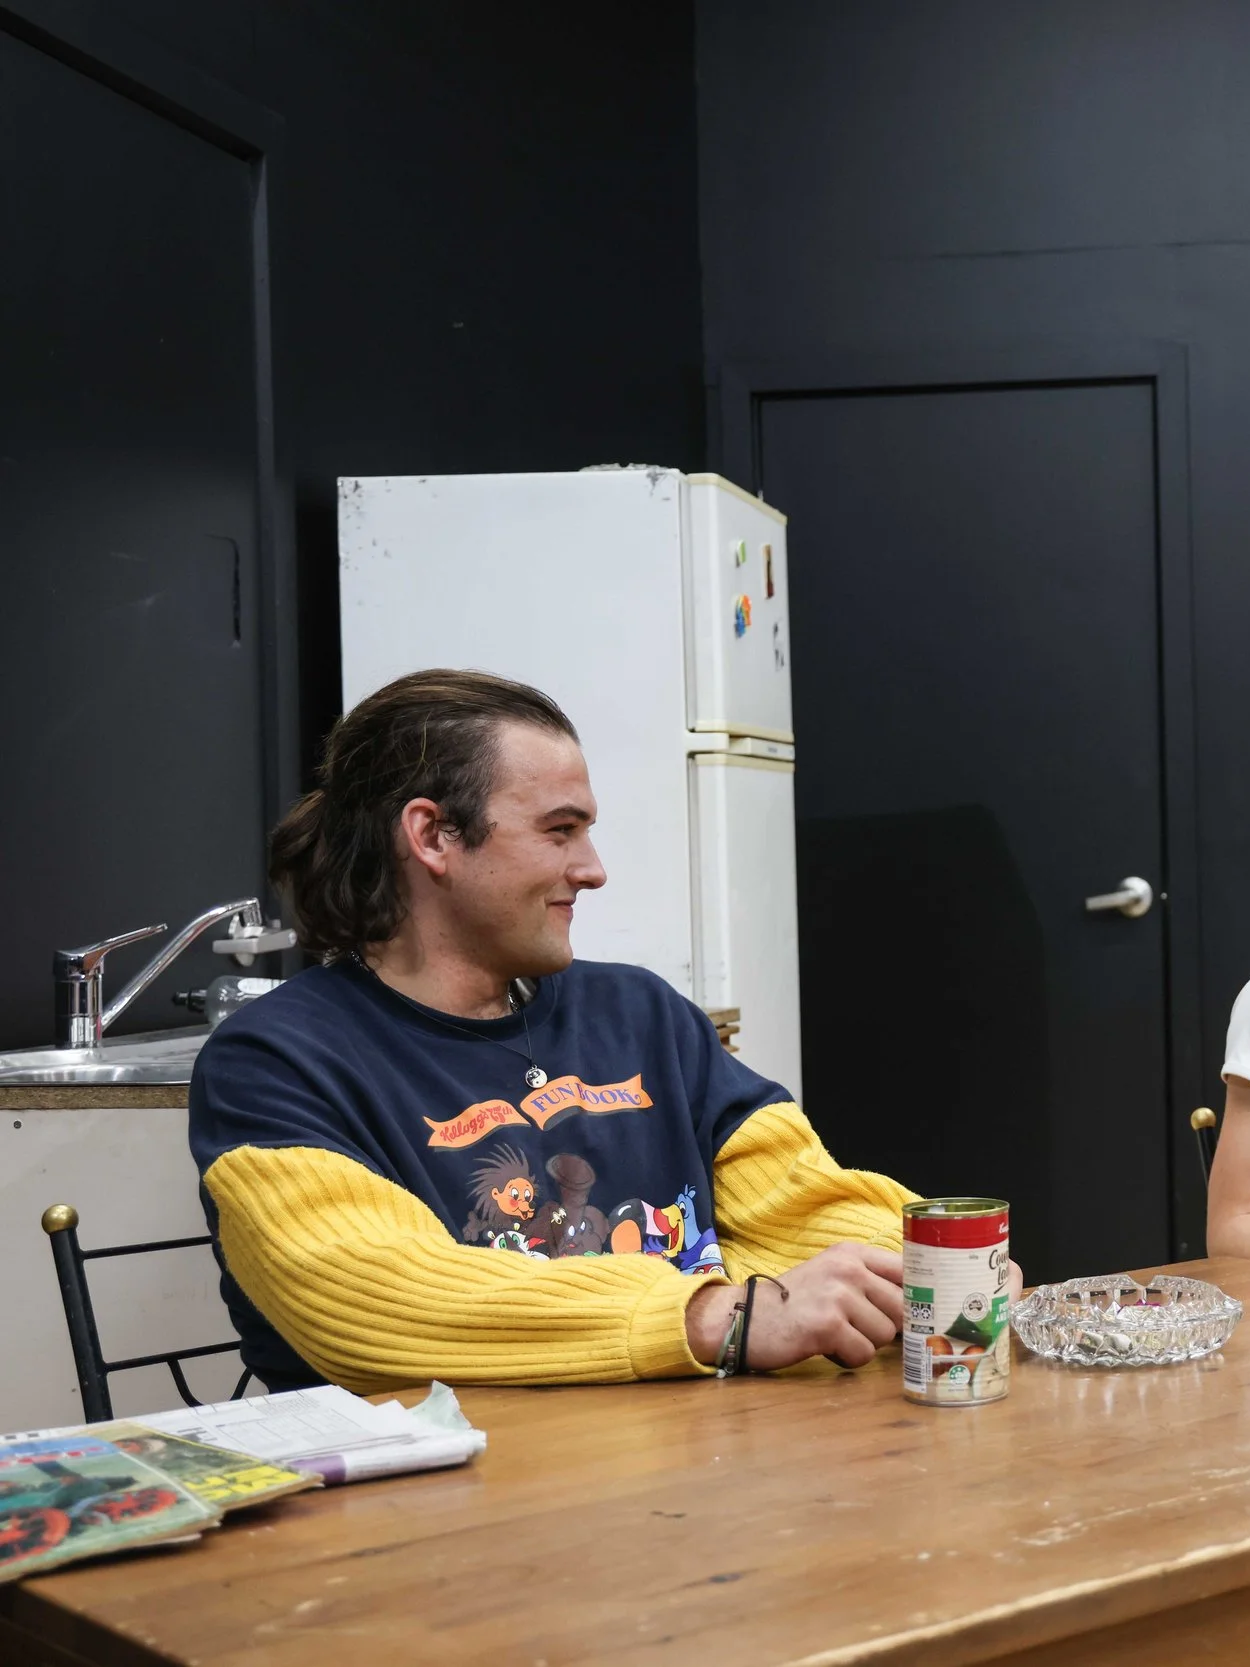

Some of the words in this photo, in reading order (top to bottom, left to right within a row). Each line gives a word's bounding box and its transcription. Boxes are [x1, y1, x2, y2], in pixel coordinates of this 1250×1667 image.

[531, 1083, 575, 1112] FUN
[575, 1082, 642, 1106] BOOK
[440, 1109, 489, 1142] Kellogg's
